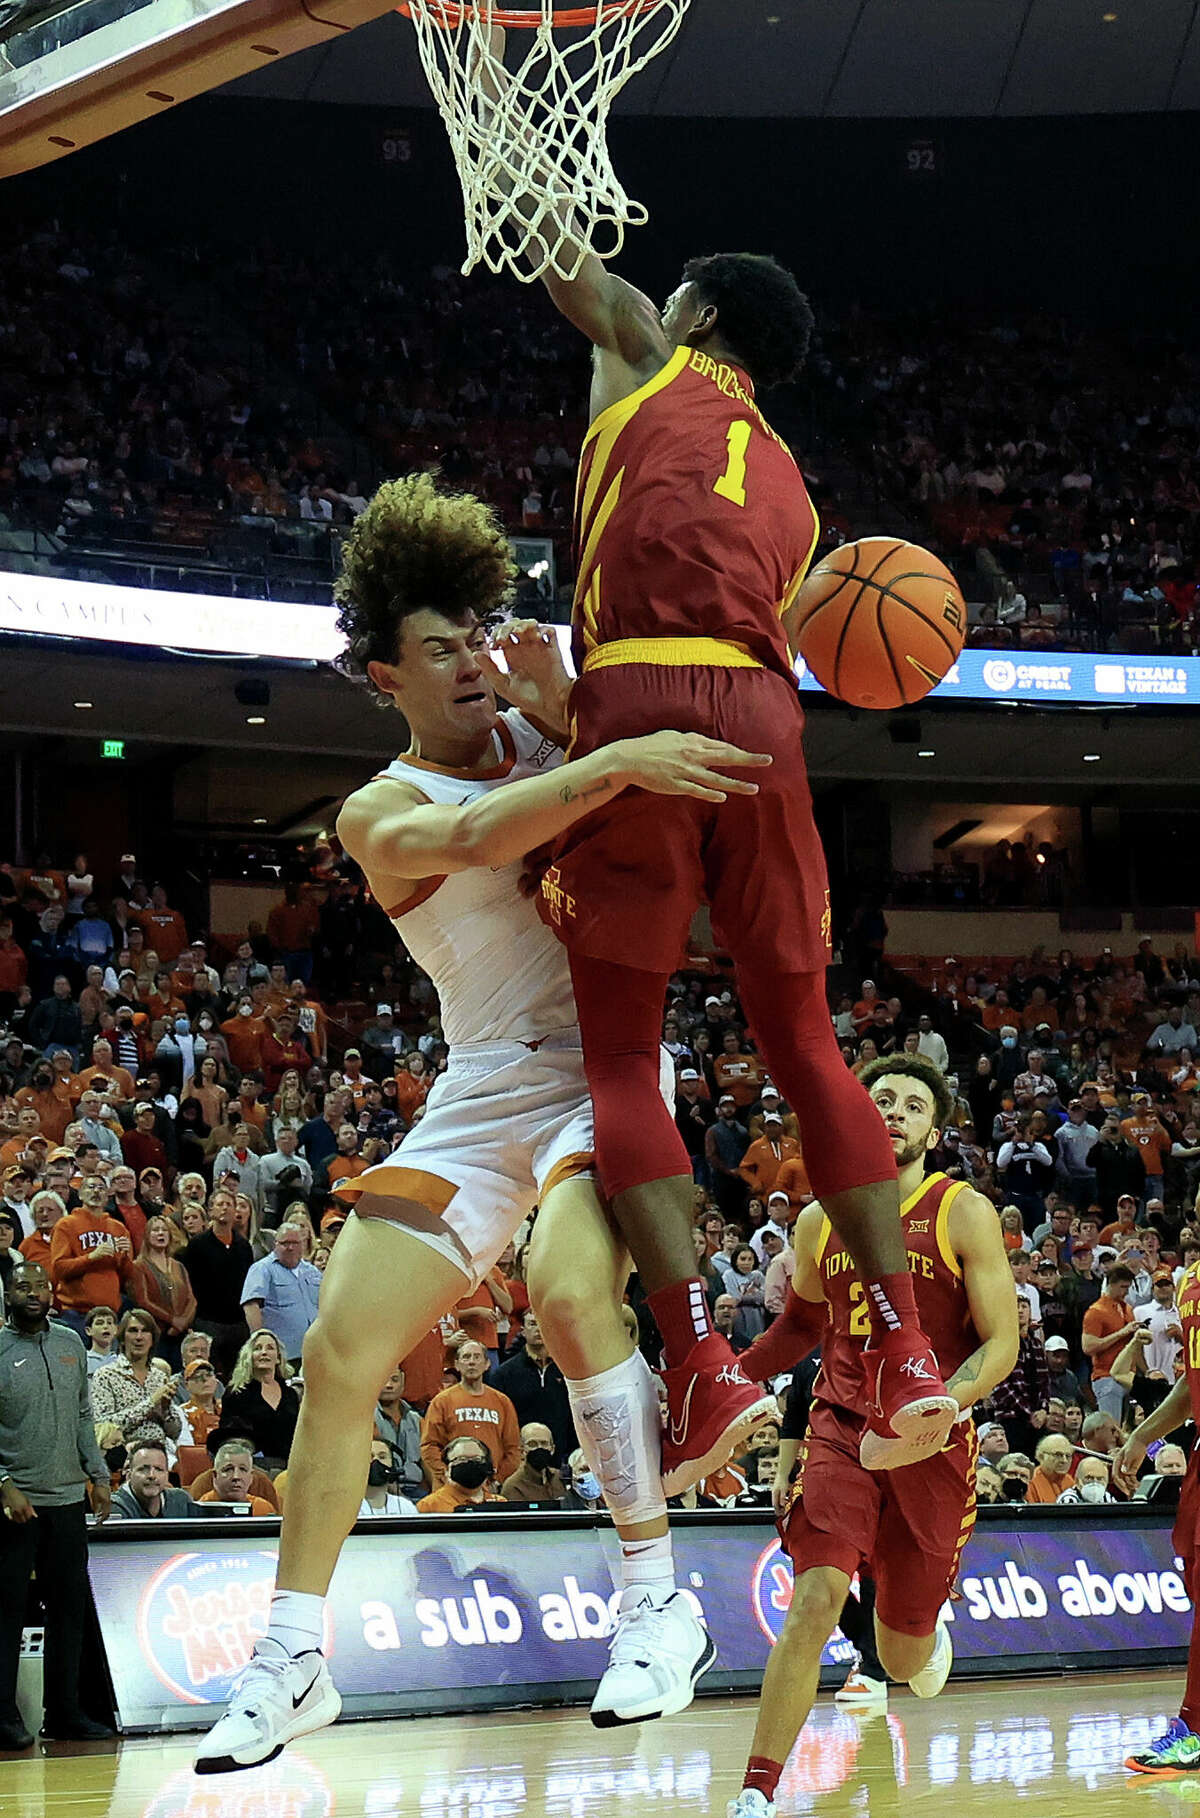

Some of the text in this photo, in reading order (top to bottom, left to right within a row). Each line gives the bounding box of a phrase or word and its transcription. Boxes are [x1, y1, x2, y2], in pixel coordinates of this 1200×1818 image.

[713, 420, 752, 508] 1
[1125, 667, 1174, 681] TEXAN
[104, 740, 124, 758] EXIT
[78, 1230, 121, 1254] TEXA
[825, 1251, 856, 1280] IOW
[454, 1407, 500, 1425] TEXAS
[962, 1560, 1191, 1620] sub above
[163, 1582, 275, 1640] Jerse
[360, 1601, 401, 1650] a
[415, 1579, 523, 1647] sub
